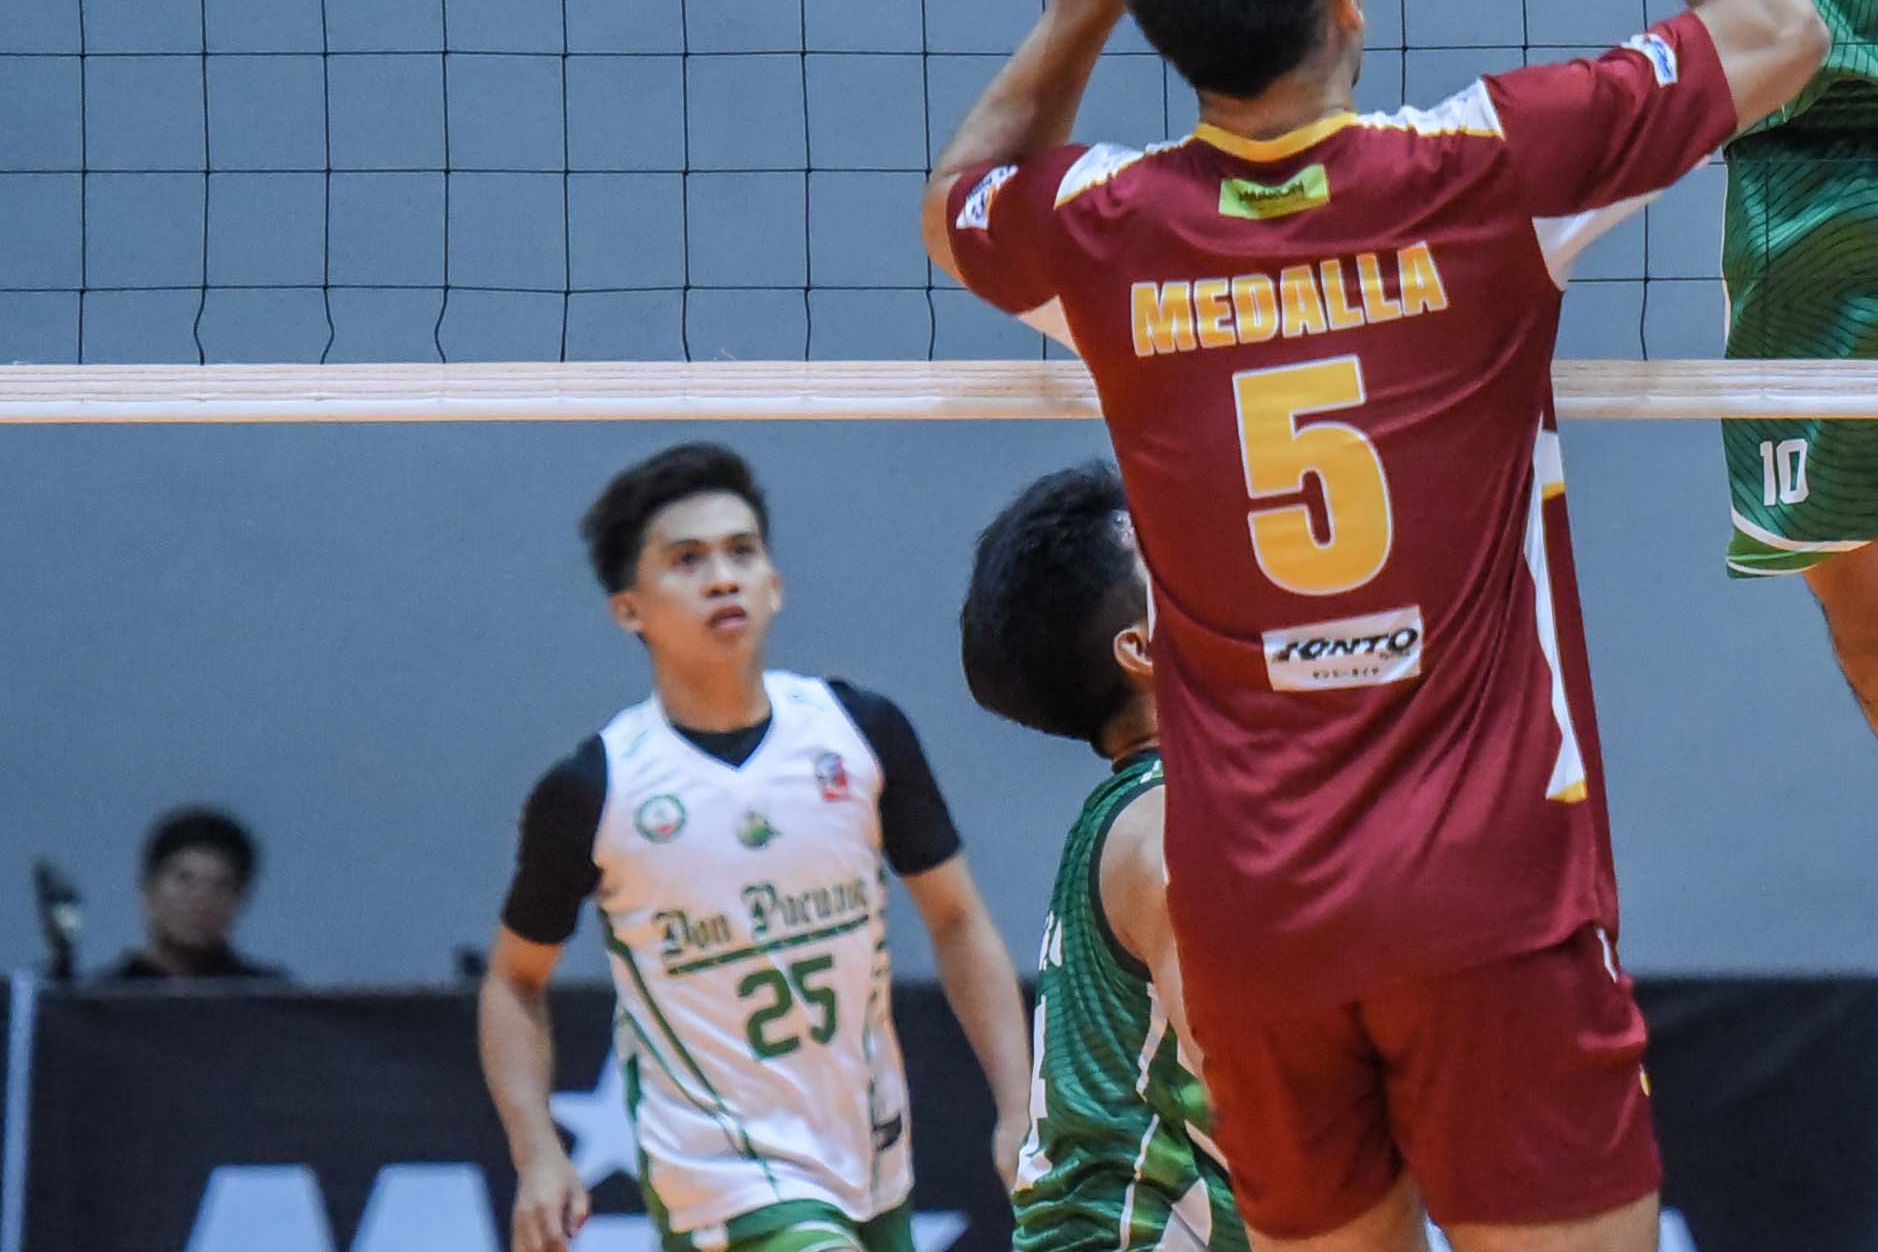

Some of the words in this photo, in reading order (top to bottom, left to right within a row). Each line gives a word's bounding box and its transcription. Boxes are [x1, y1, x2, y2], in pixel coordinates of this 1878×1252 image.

[1130, 241, 1448, 357] MEDALLA
[1232, 353, 1393, 597] 5
[1759, 438, 1809, 507] 10
[651, 909, 732, 959] Don
[737, 954, 837, 1059] 25
